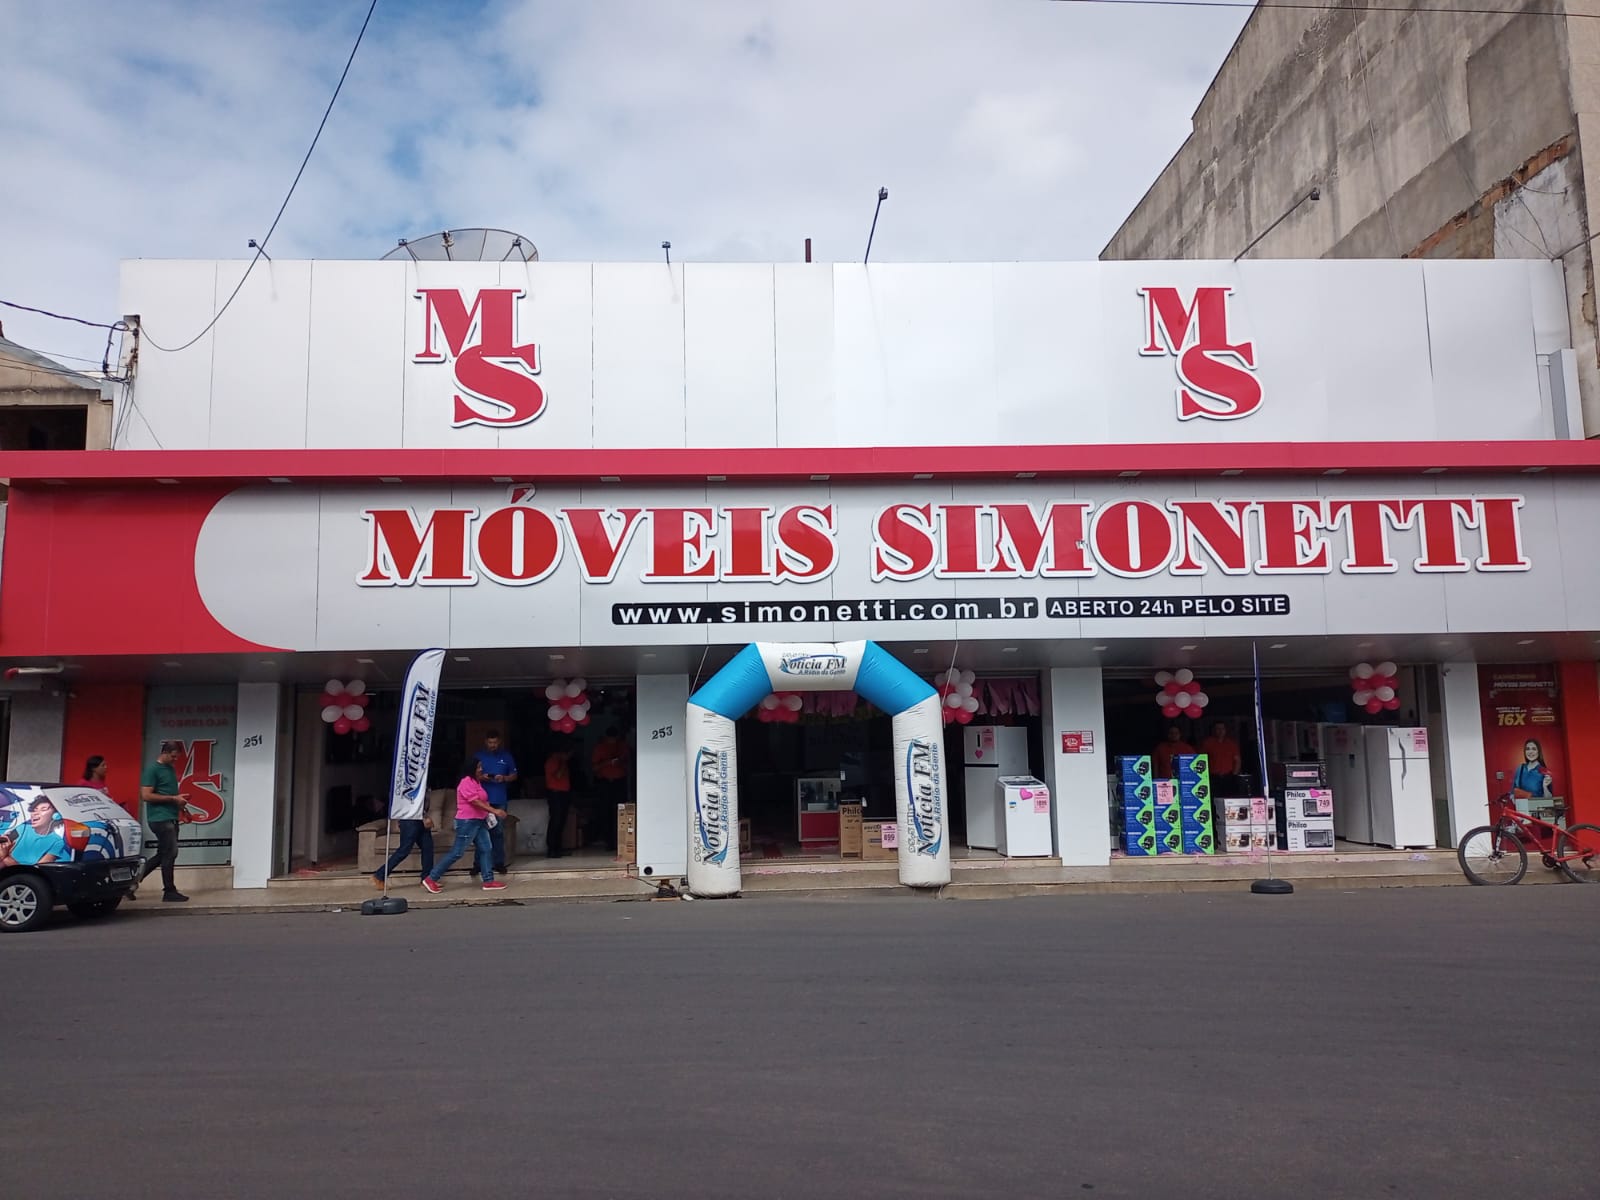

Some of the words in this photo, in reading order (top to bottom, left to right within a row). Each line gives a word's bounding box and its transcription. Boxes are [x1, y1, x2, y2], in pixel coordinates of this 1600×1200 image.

[359, 486, 836, 580] MÓVEIS
[874, 497, 1523, 577] SIMONETTI
[618, 598, 1034, 623] www.simonetti.com.br
[1049, 600, 1133, 615] ABERTO
[1140, 599, 1174, 615] 24h
[1181, 598, 1234, 614] PELO
[1242, 597, 1286, 613] SITE
[780, 657, 822, 671] Notícia
[826, 658, 846, 670] FM
[428, 691, 437, 718] Gente
[652, 725, 672, 740] 253
[1498, 714, 1526, 726] 16X
[244, 735, 263, 749] 251
[402, 728, 425, 804] Notícia
[414, 684, 430, 723] FM
[701, 750, 719, 786] FM
[721, 751, 729, 779] Gente
[914, 742, 932, 778] FM
[932, 743, 940, 771] Gente
[721, 780, 729, 793] da
[932, 771, 940, 786] da
[702, 791, 723, 868] Notícia
[915, 783, 937, 859] Notícia
[1288, 822, 1307, 830] Philco
